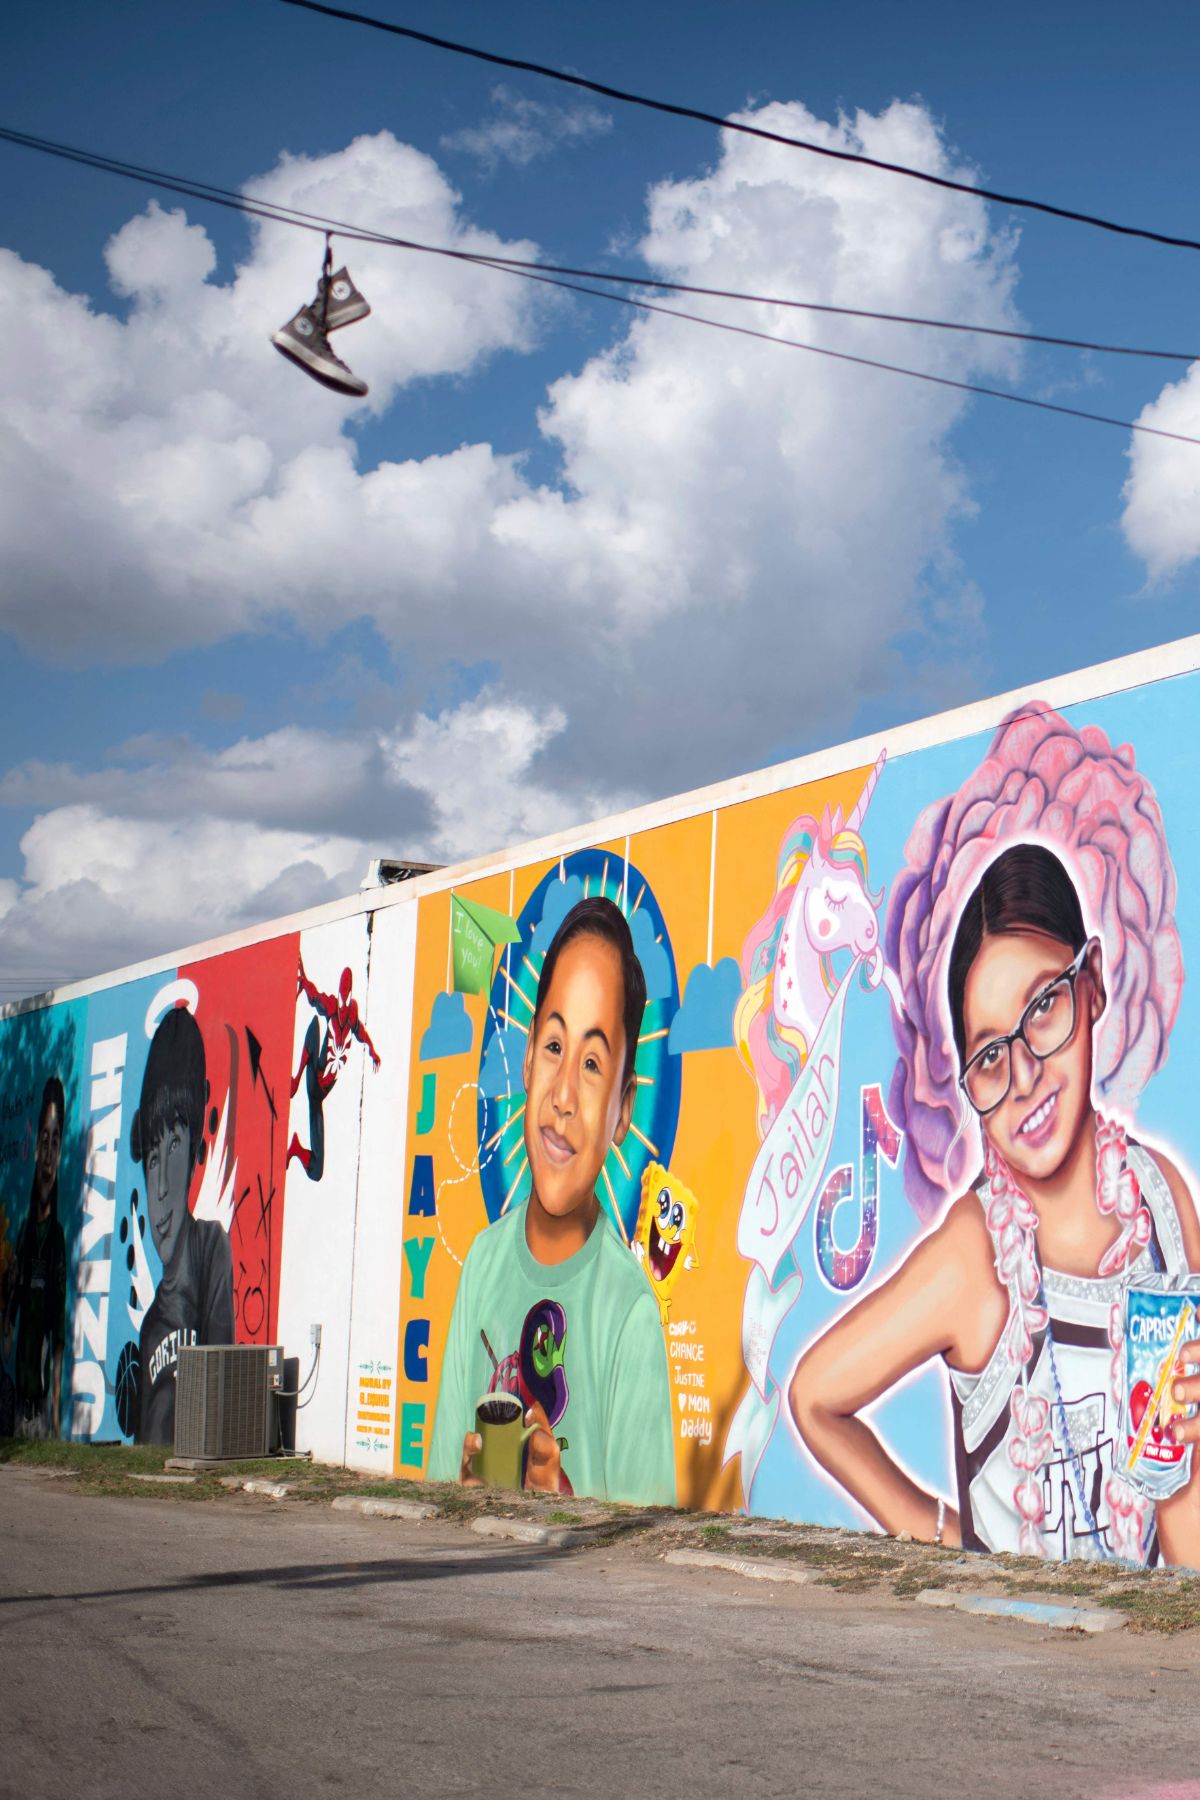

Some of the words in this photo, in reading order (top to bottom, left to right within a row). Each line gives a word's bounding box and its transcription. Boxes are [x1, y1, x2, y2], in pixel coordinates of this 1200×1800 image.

[454, 911, 464, 934] I
[465, 919, 484, 952] love
[670, 1341, 704, 1361] CHANCE
[688, 1394, 710, 1413] MOM
[680, 1417, 712, 1446] Daddy
